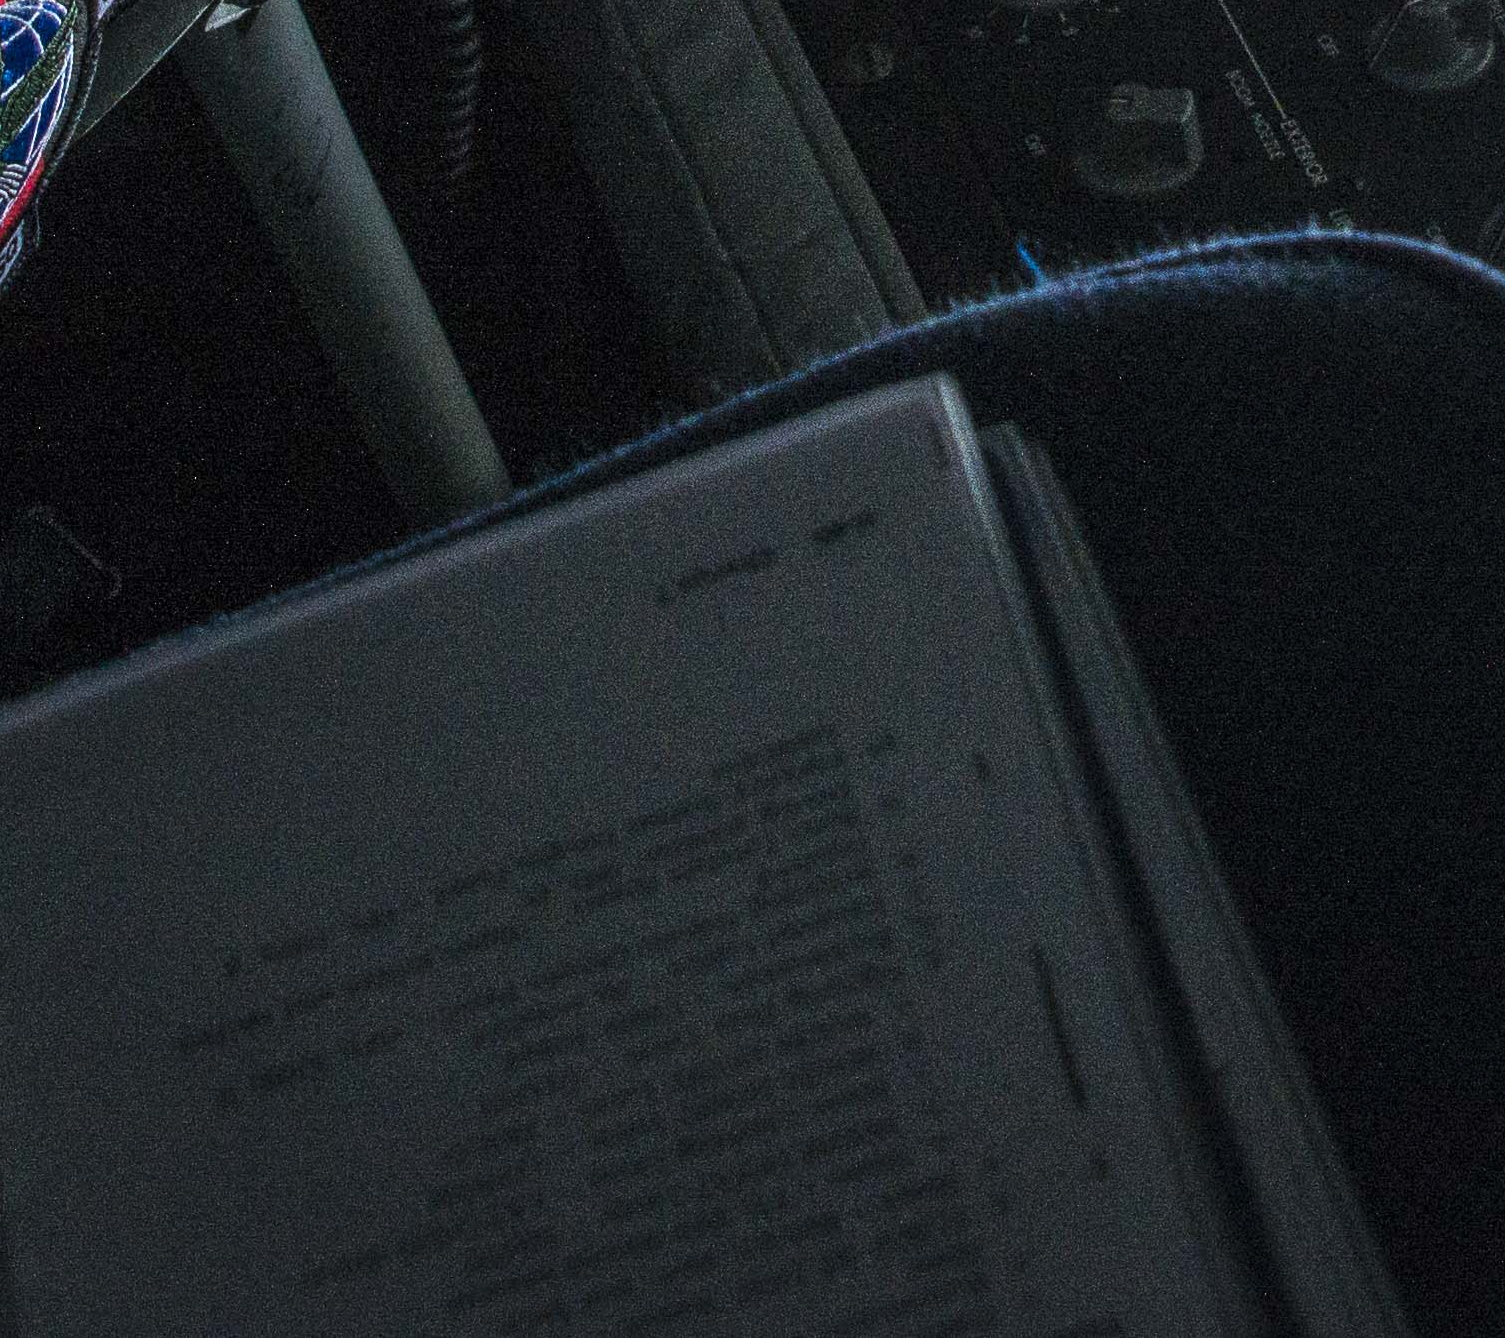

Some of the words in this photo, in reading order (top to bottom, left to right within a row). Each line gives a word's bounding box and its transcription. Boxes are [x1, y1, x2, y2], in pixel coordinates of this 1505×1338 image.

[1315, 34, 1340, 58] OFF
[1225, 69, 1256, 107] BOOM
[1280, 120, 1327, 184] EXTERIOR
